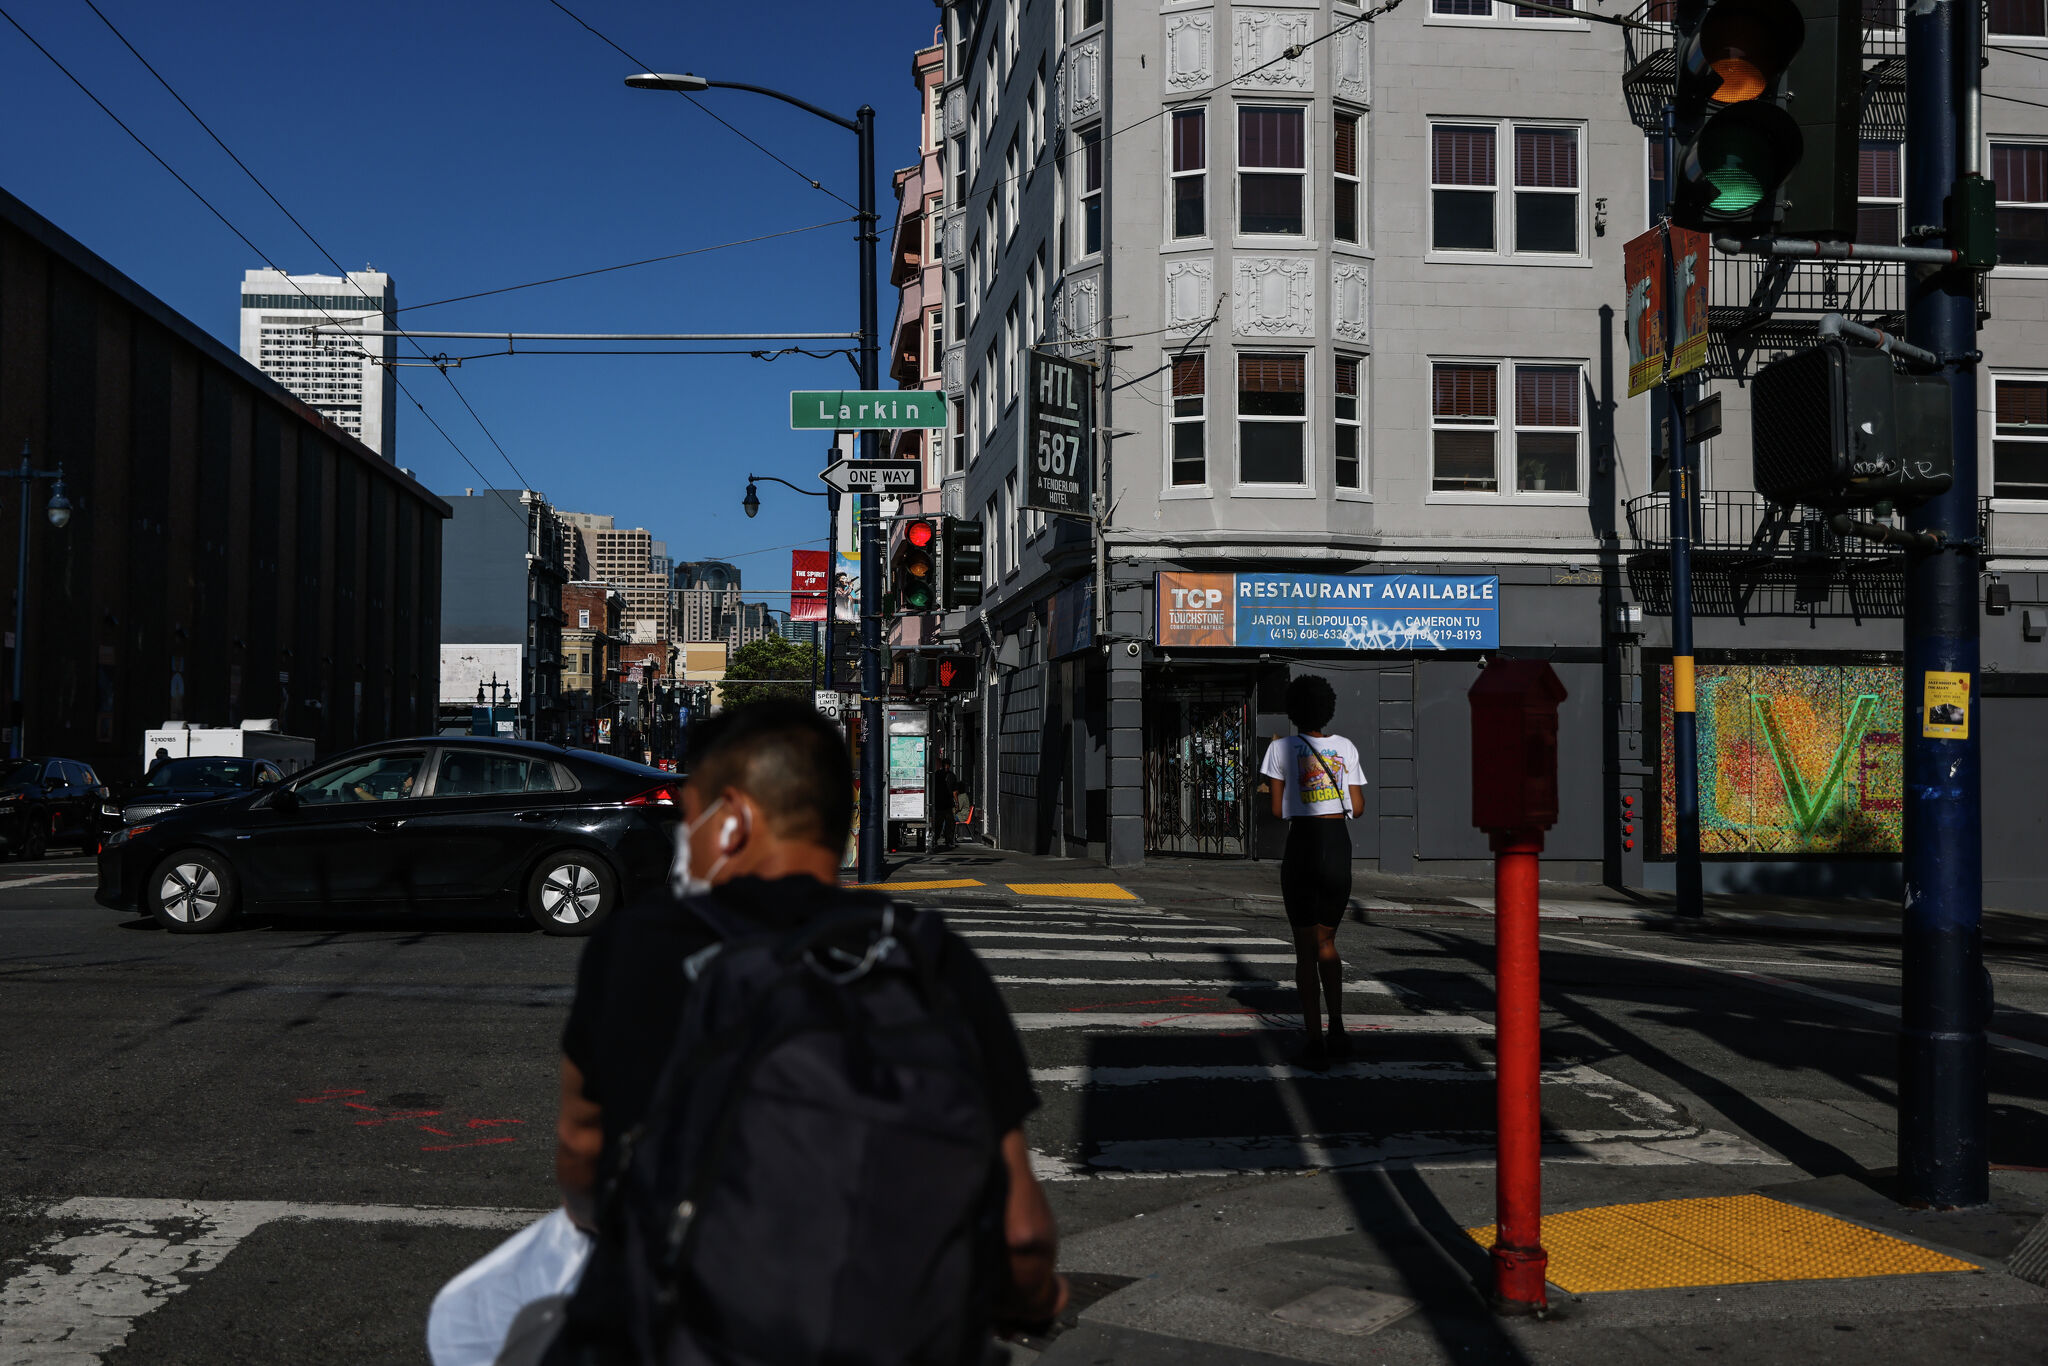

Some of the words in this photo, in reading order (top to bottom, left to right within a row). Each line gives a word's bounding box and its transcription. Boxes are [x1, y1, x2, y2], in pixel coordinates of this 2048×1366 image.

[1039, 361, 1078, 410] HTL
[819, 400, 919, 420] Larkin
[1037, 430, 1080, 477] 587
[850, 470, 876, 483] ONE
[882, 470, 911, 483] WAY
[1037, 476, 1043, 489] A
[1043, 477, 1080, 494] TENDERLOIN
[1049, 491, 1069, 505] HOTEL
[1240, 582, 1374, 599] RESTAURANT
[1381, 583, 1494, 600] AVAILABLE
[1170, 588, 1222, 609] TCP
[1169, 612, 1225, 625] TOUCHSTONE
[1251, 615, 1290, 626] JARON
[1297, 615, 1368, 627] ELIOPOULOS
[1405, 616, 1462, 627] CAMERON
[1465, 616, 1480, 627] TU
[1270, 628, 1298, 641] (415)
[1300, 629, 1349, 640] 608-6336
[1433, 629, 1482, 641] 919-8193
[818, 706, 837, 717] 20
